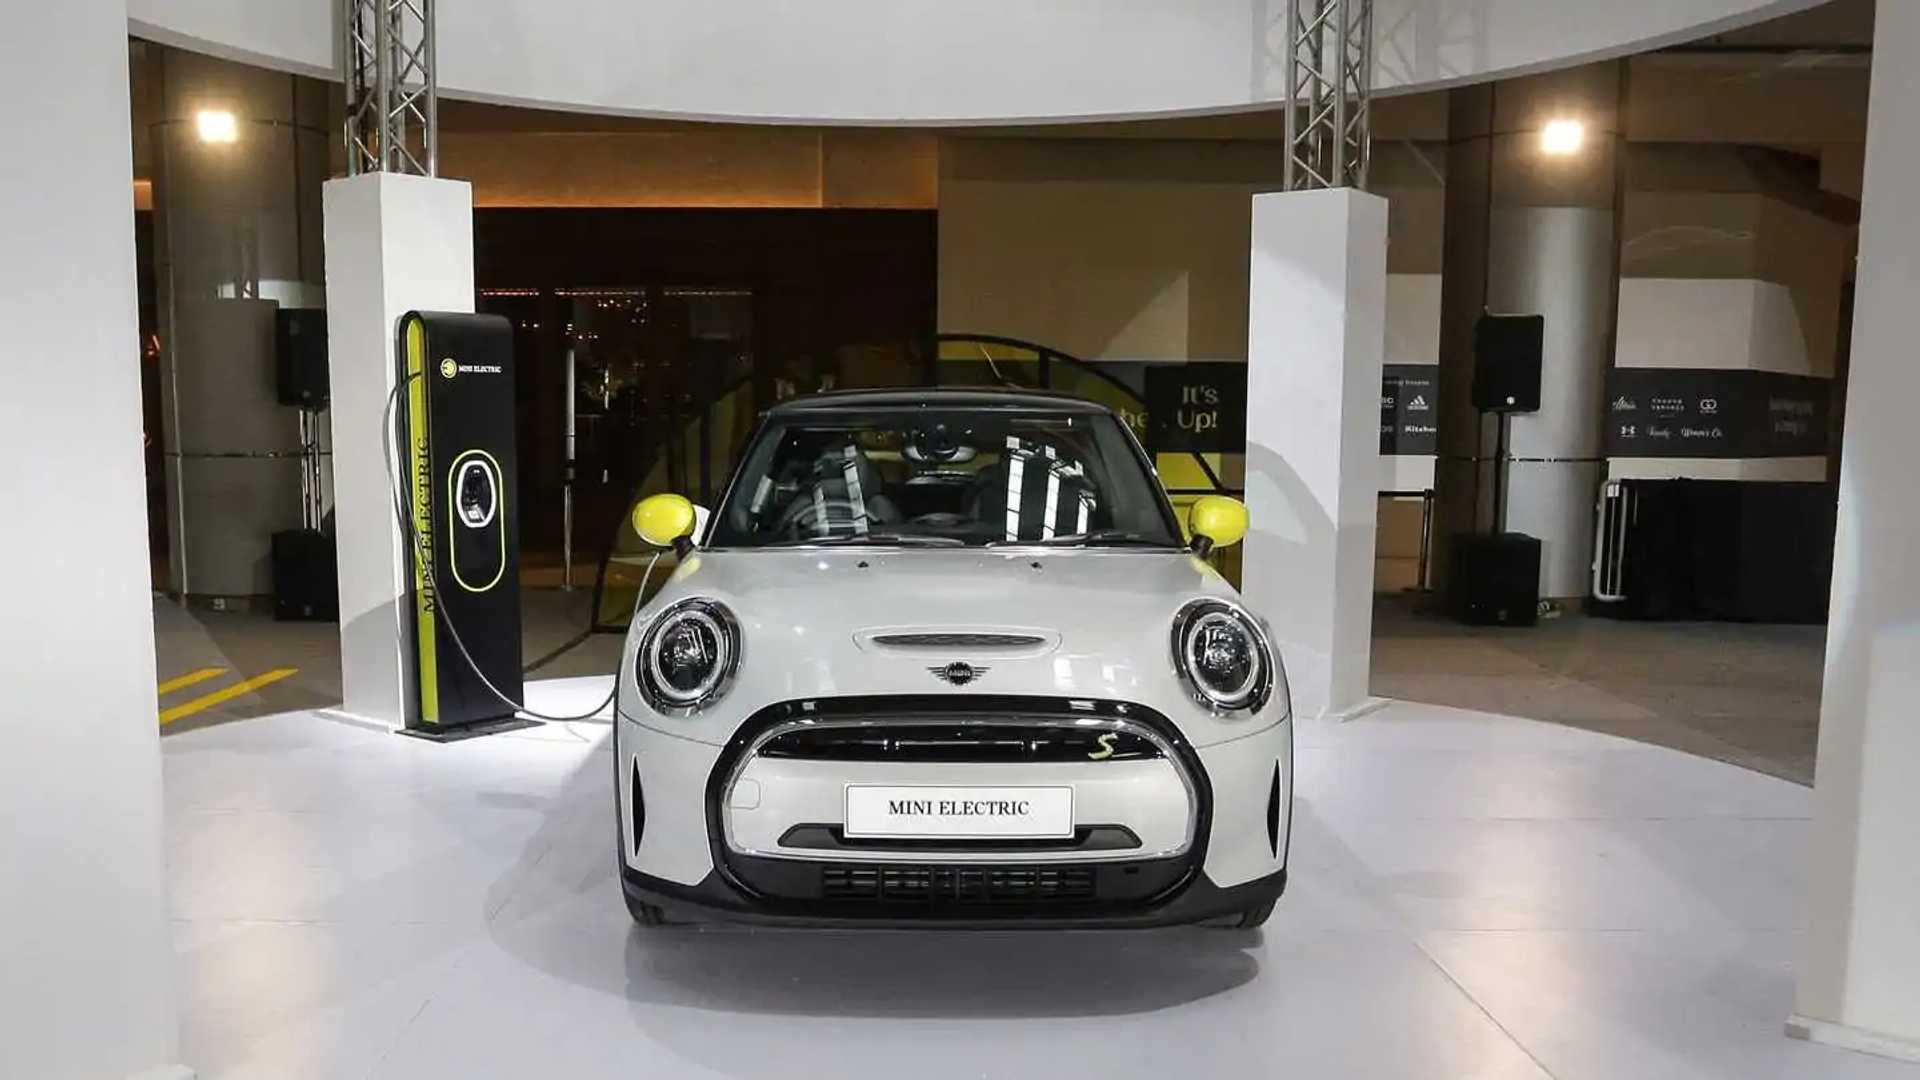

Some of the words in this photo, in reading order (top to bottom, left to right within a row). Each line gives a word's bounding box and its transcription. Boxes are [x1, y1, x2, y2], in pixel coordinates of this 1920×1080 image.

[1183, 385, 1219, 405] It's
[1177, 410, 1218, 433] Up!
[418, 437, 432, 551] ELECTRIC
[1087, 732, 1119, 760] S
[888, 800, 933, 816] MINI
[939, 800, 1030, 816] ELECTRIC
